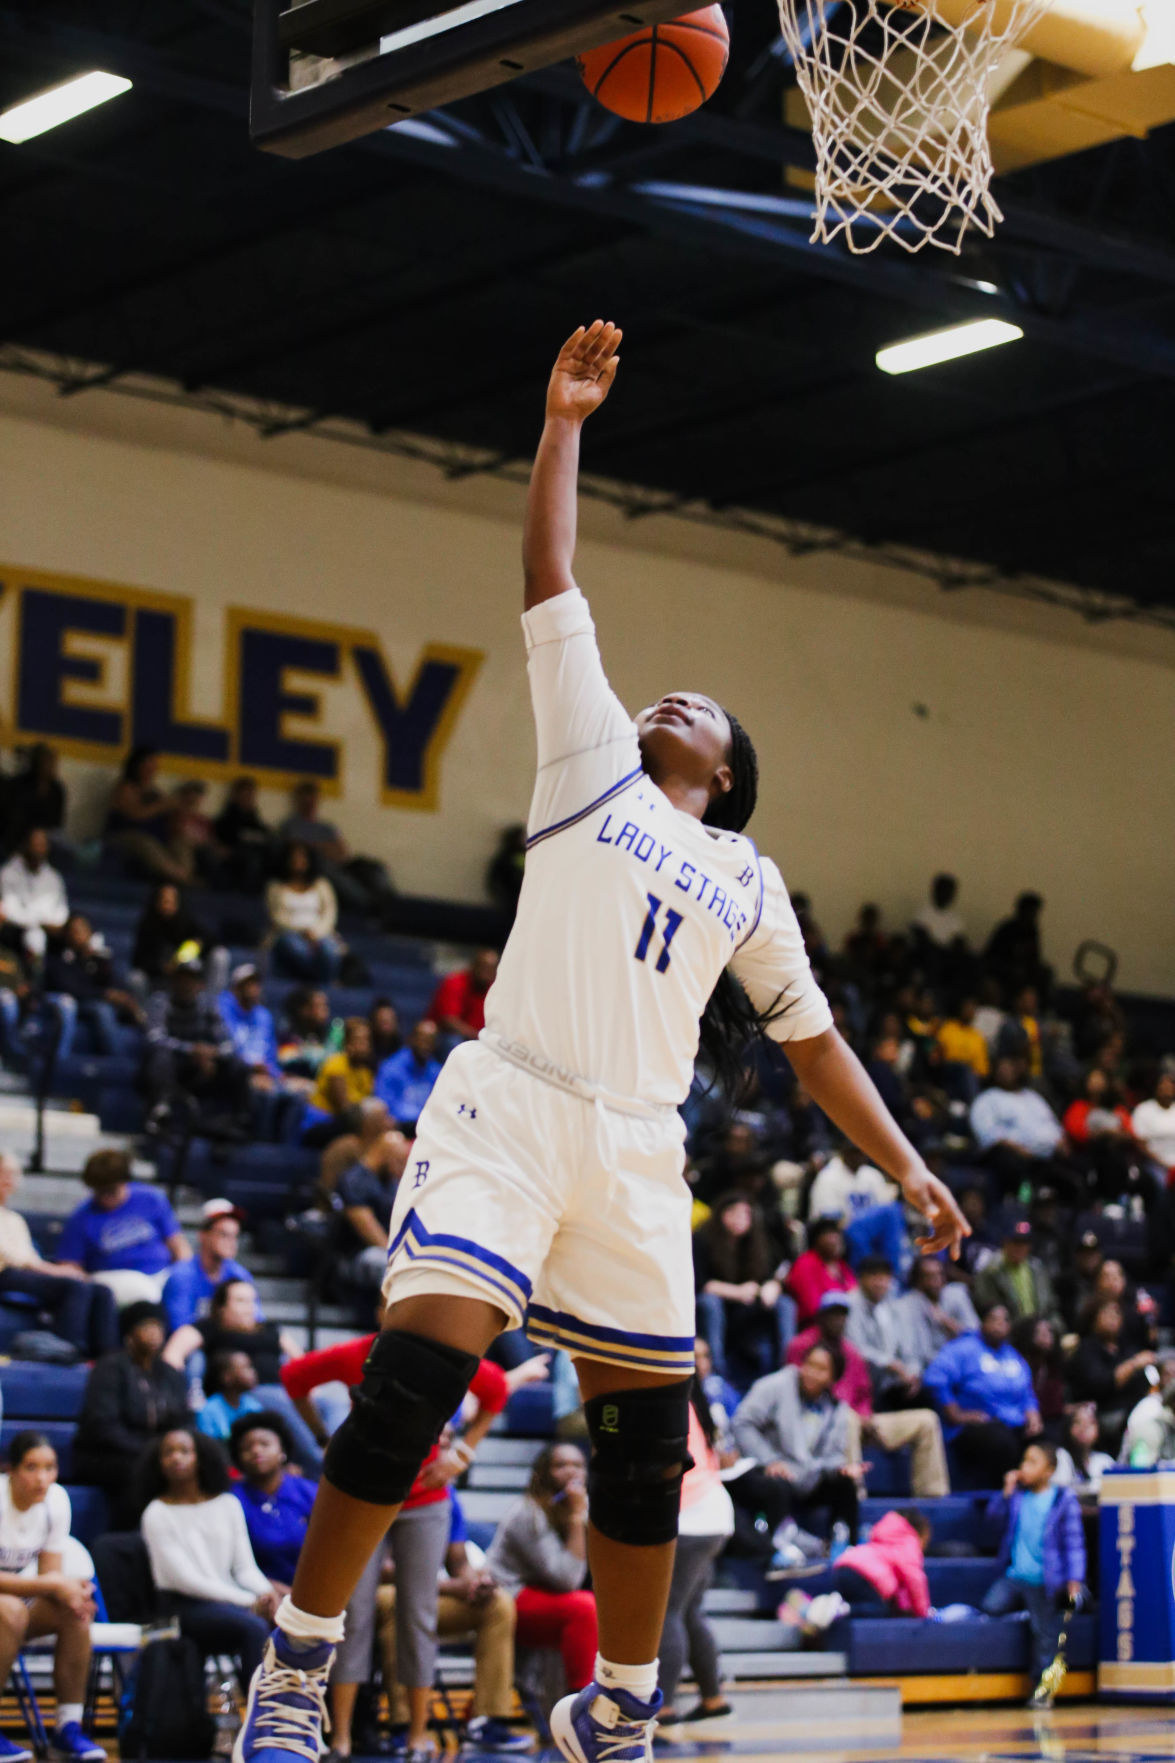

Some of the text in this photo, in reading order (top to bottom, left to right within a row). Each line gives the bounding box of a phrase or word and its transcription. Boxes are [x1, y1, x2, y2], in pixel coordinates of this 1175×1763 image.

[0, 563, 486, 813] ELEY
[596, 814, 672, 872] LADY
[736, 864, 754, 887] B
[634, 892, 684, 974] 11
[411, 1160, 430, 1189] B
